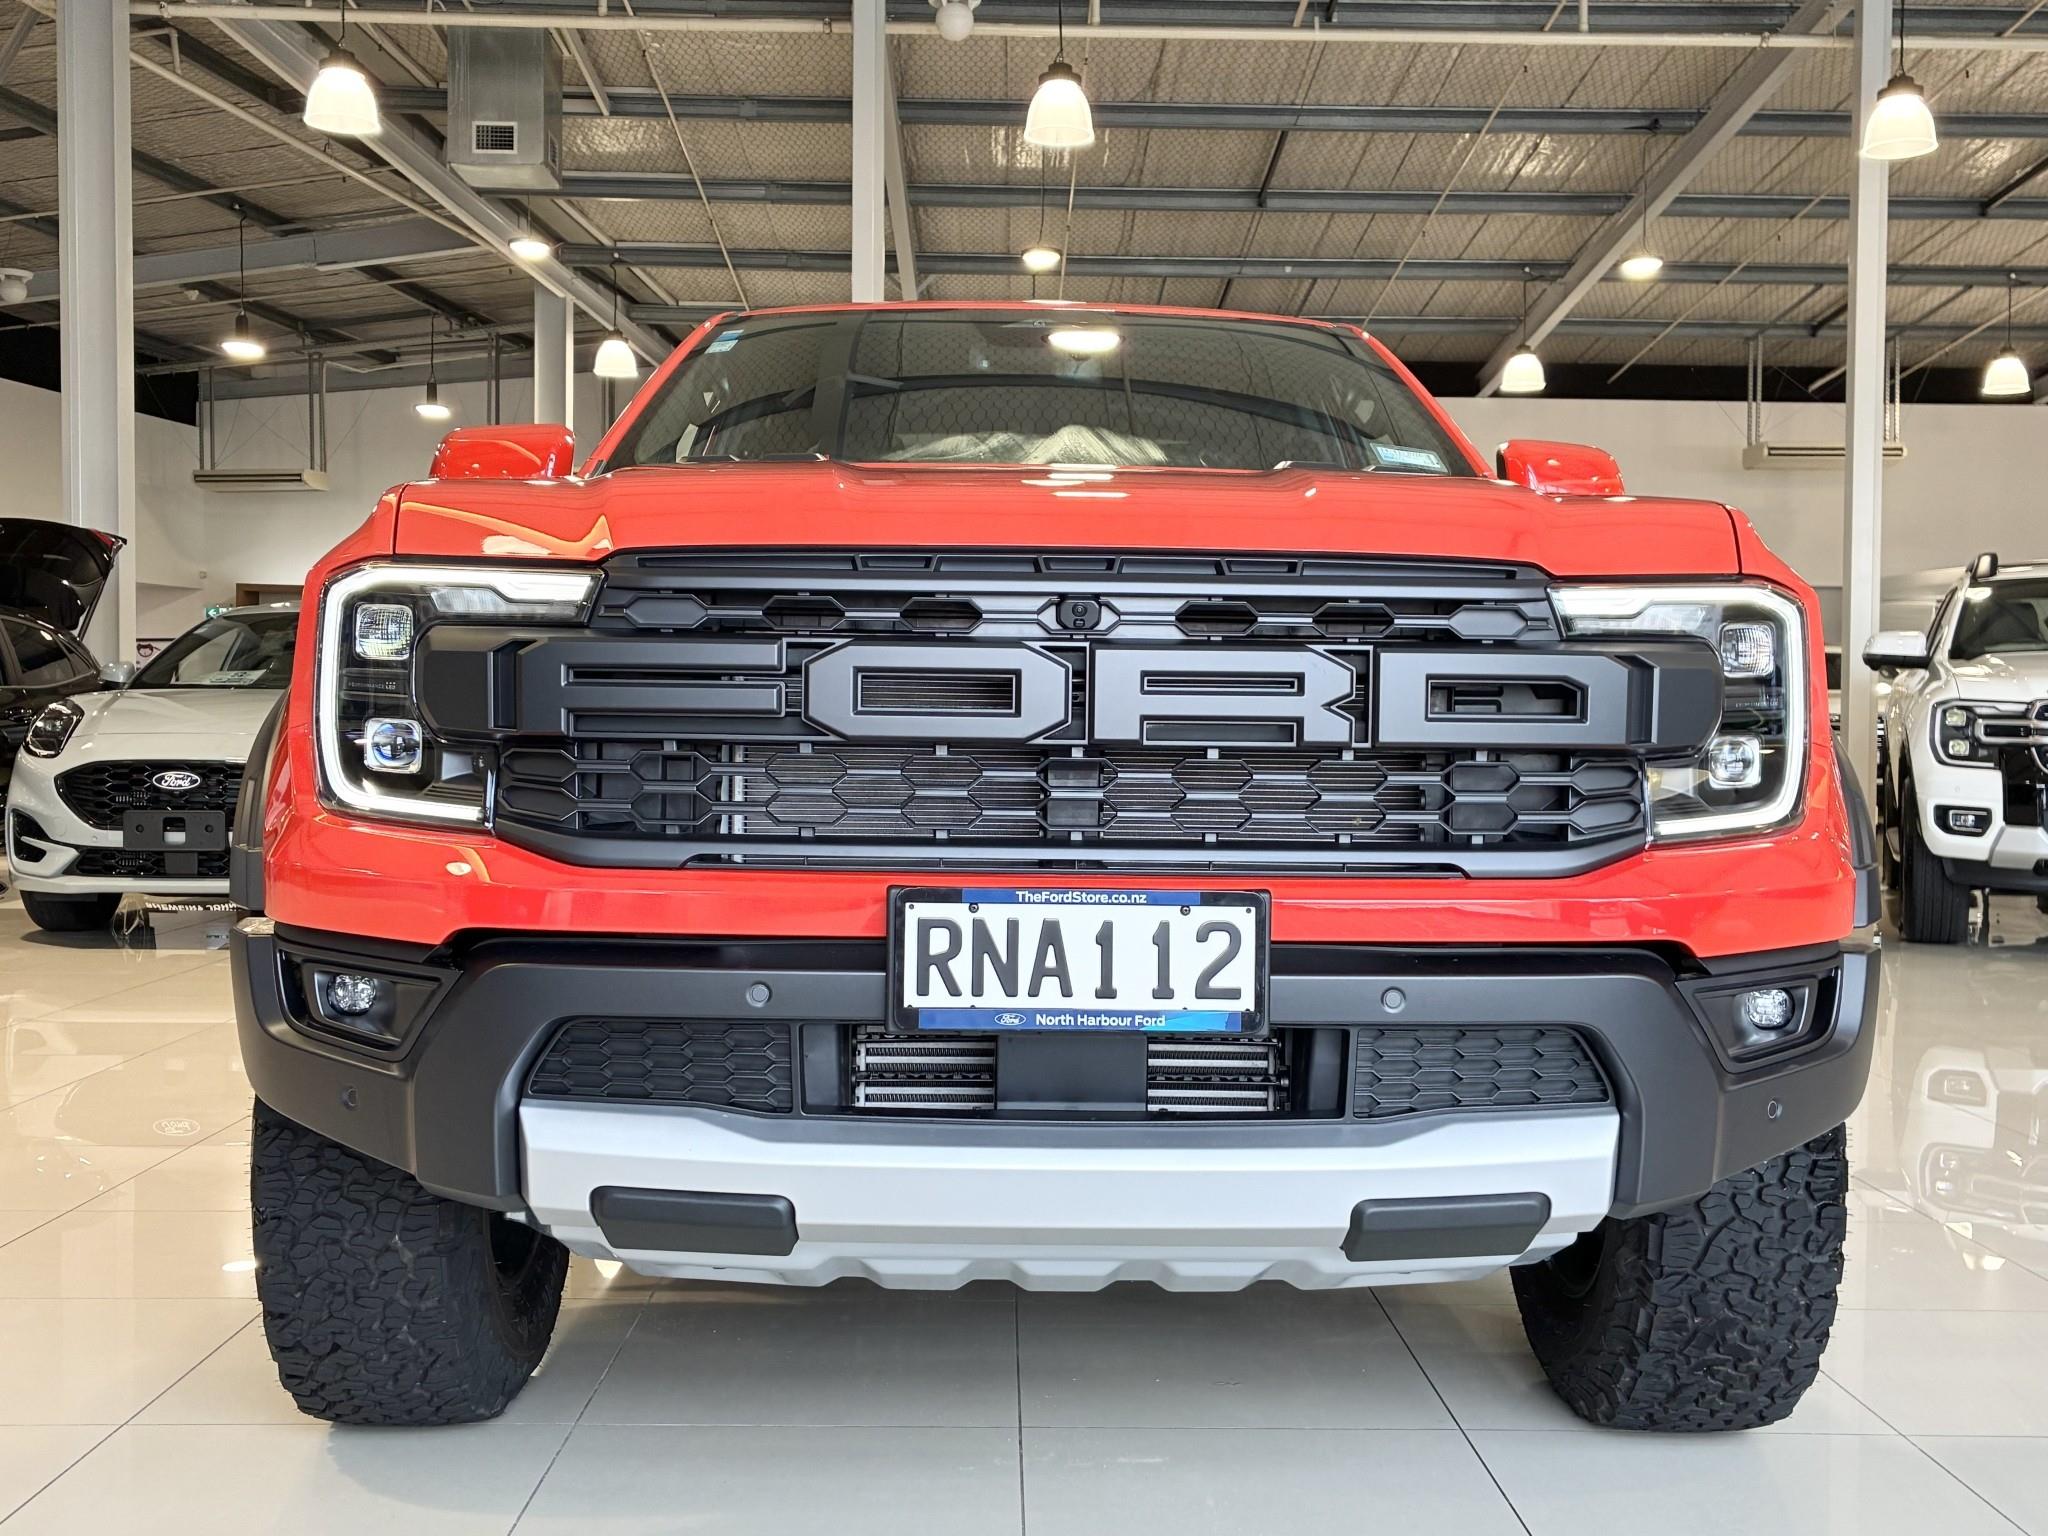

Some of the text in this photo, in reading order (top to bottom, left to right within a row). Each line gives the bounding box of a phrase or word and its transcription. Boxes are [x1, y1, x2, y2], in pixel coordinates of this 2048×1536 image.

[514, 637, 1629, 748] FORD
[160, 773, 193, 788] Ford
[1015, 890, 1147, 904] TheFordStore.co.nz
[916, 917, 1242, 1000] RNA112
[1000, 1014, 1021, 1024] Ford
[1036, 1014, 1166, 1027] North Harbour Ford
